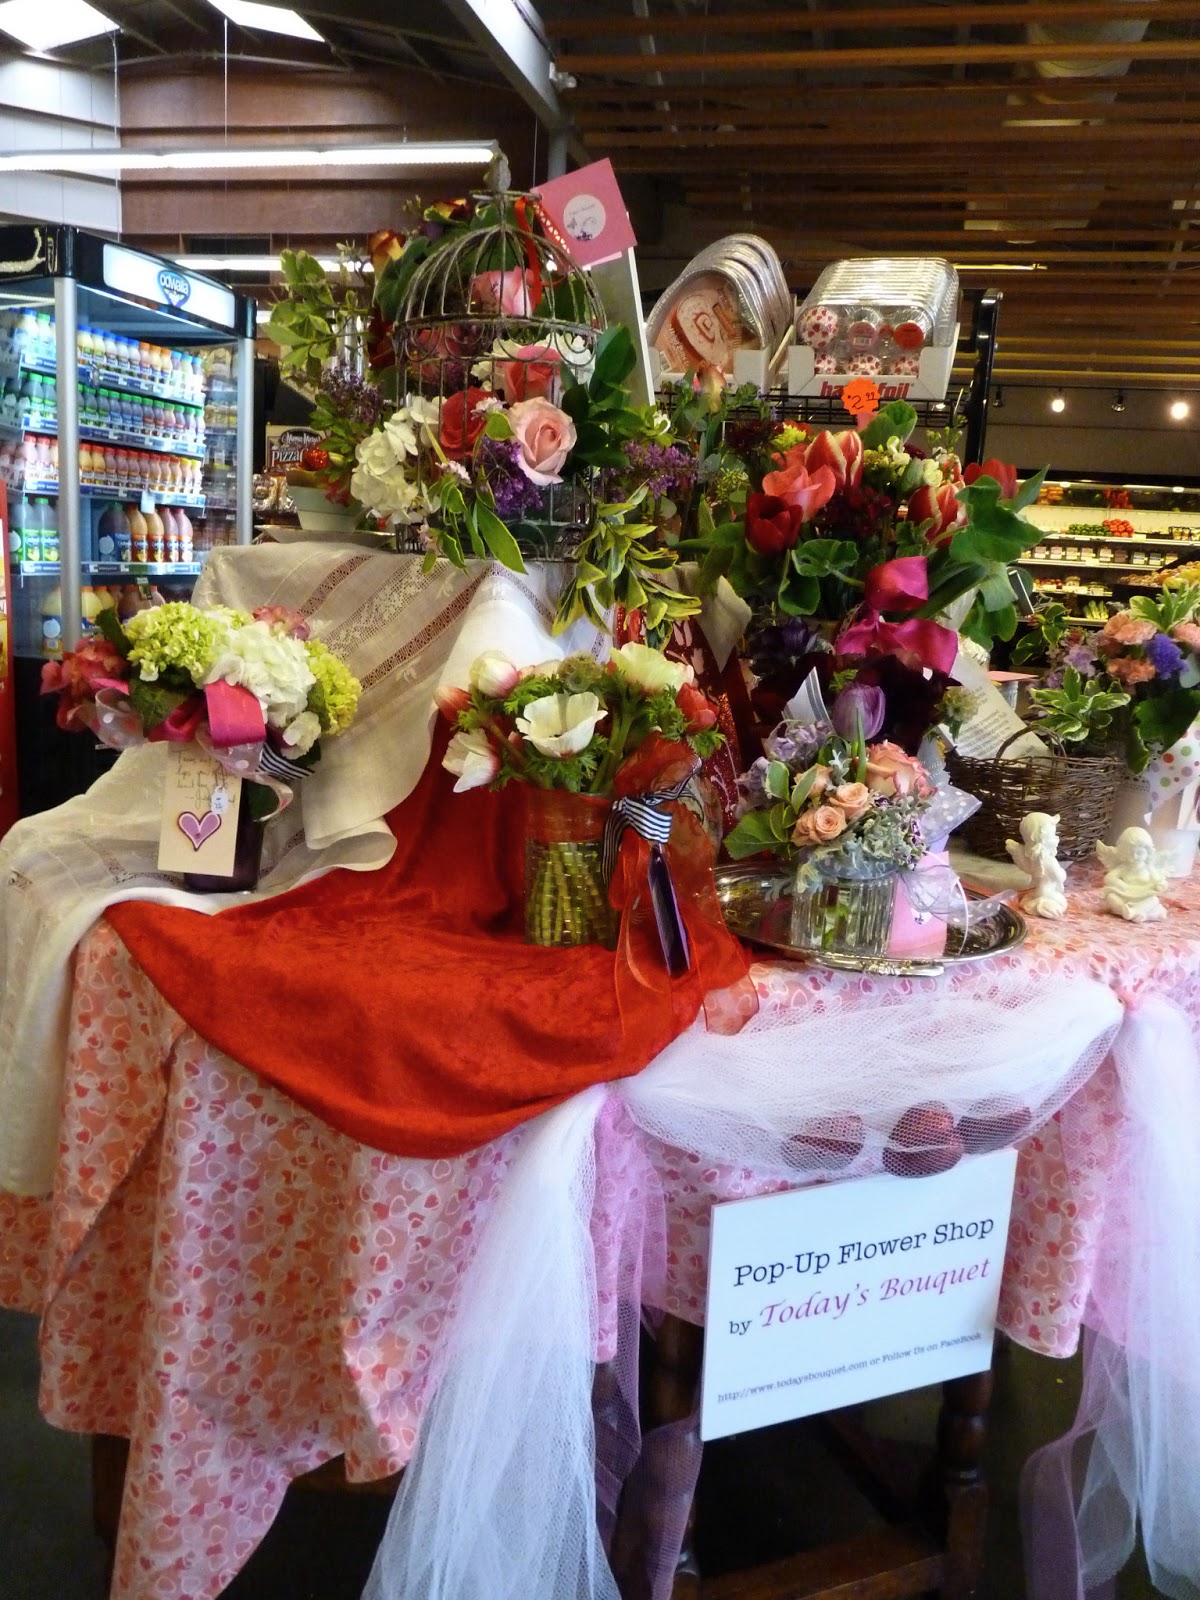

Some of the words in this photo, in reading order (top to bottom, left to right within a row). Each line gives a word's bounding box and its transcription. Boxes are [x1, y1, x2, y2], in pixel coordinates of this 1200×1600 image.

[733, 1251, 831, 1287] Pop-Up
[837, 1232, 927, 1265] Flower
[933, 1218, 994, 1245] Shop
[729, 1319, 752, 1336] by
[759, 1283, 870, 1327] Today's
[879, 1258, 990, 1301] Bouquet
[869, 1357, 881, 1366] or
[882, 1349, 912, 1363] Follow
[926, 1343, 939, 1352] on
